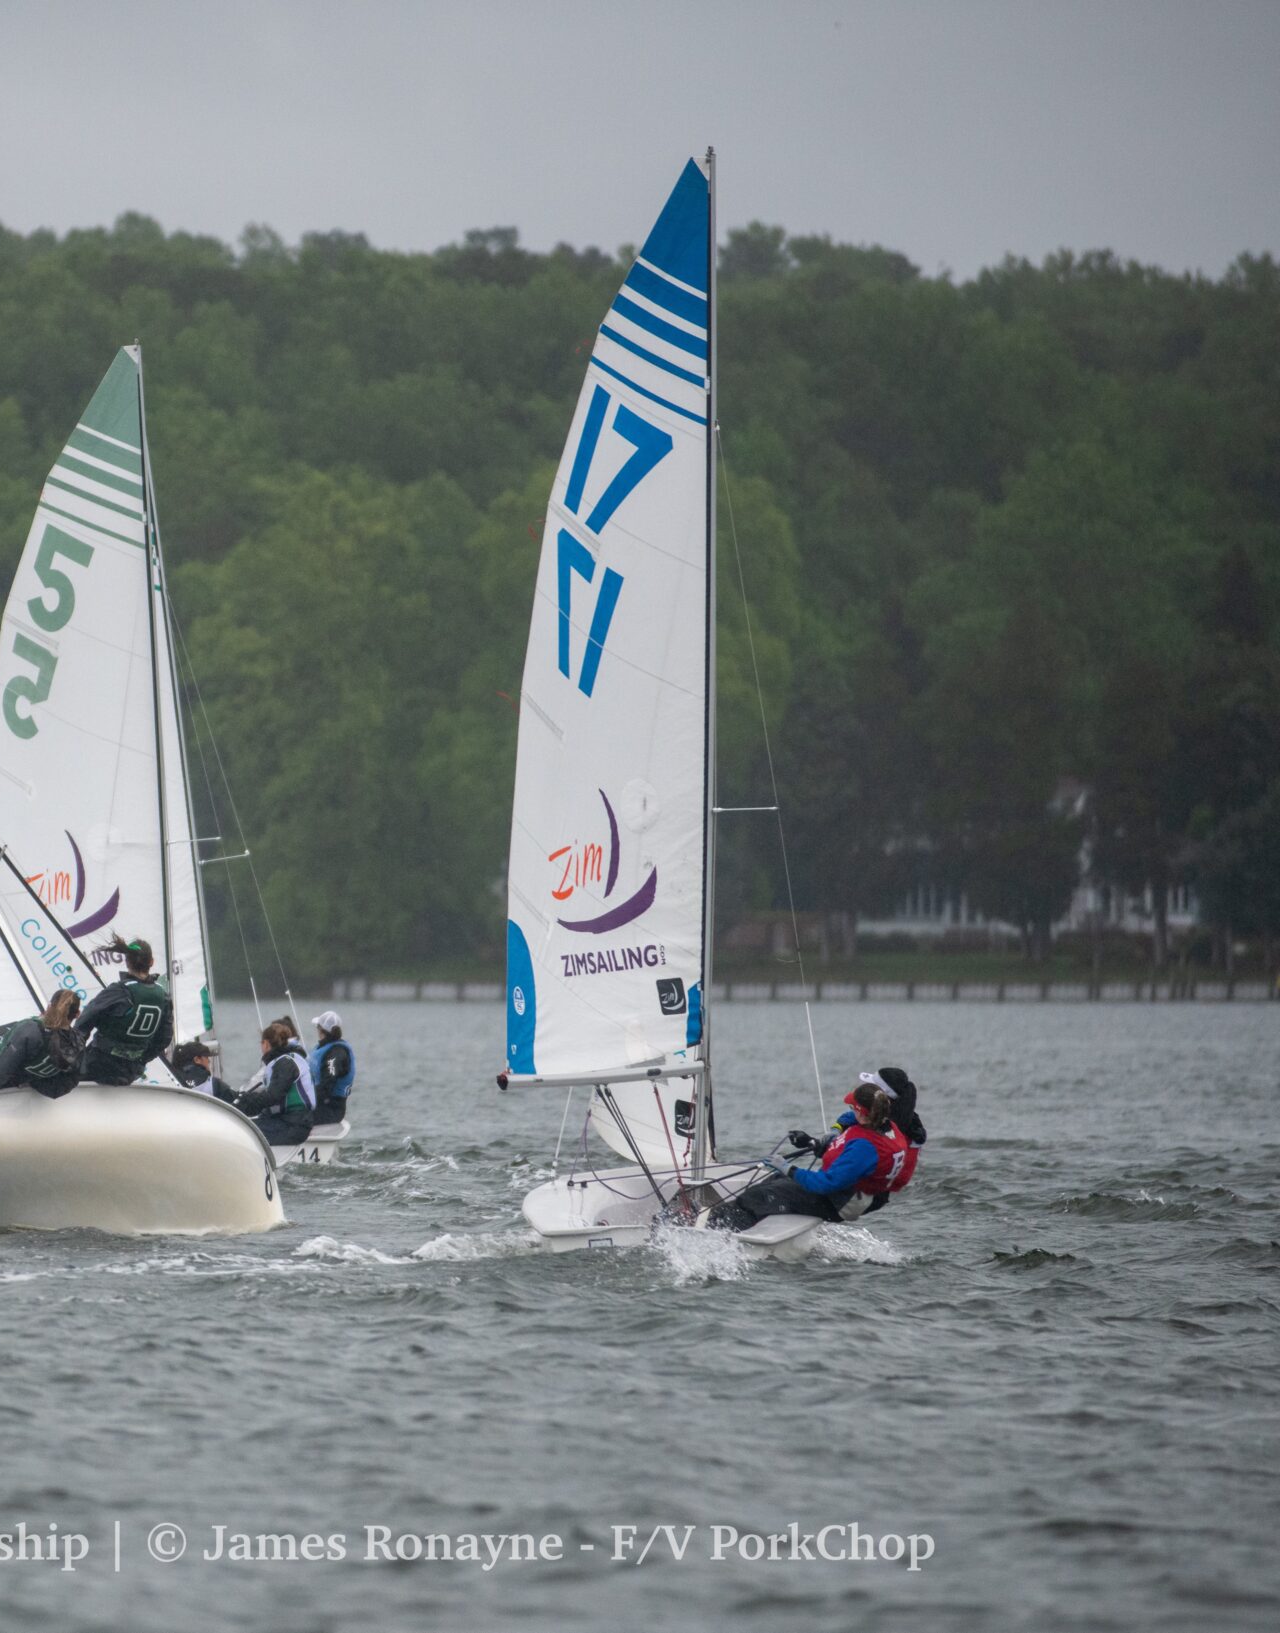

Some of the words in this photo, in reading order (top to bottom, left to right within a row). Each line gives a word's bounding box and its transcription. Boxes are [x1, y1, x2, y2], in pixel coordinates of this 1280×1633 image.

[564, 383, 673, 535] 17
[27, 524, 95, 633] 5
[20, 918, 88, 1011] College
[561, 944, 659, 977] ZIMSAILING
[126, 1004, 162, 1038] D
[296, 1146, 321, 1163] 14
